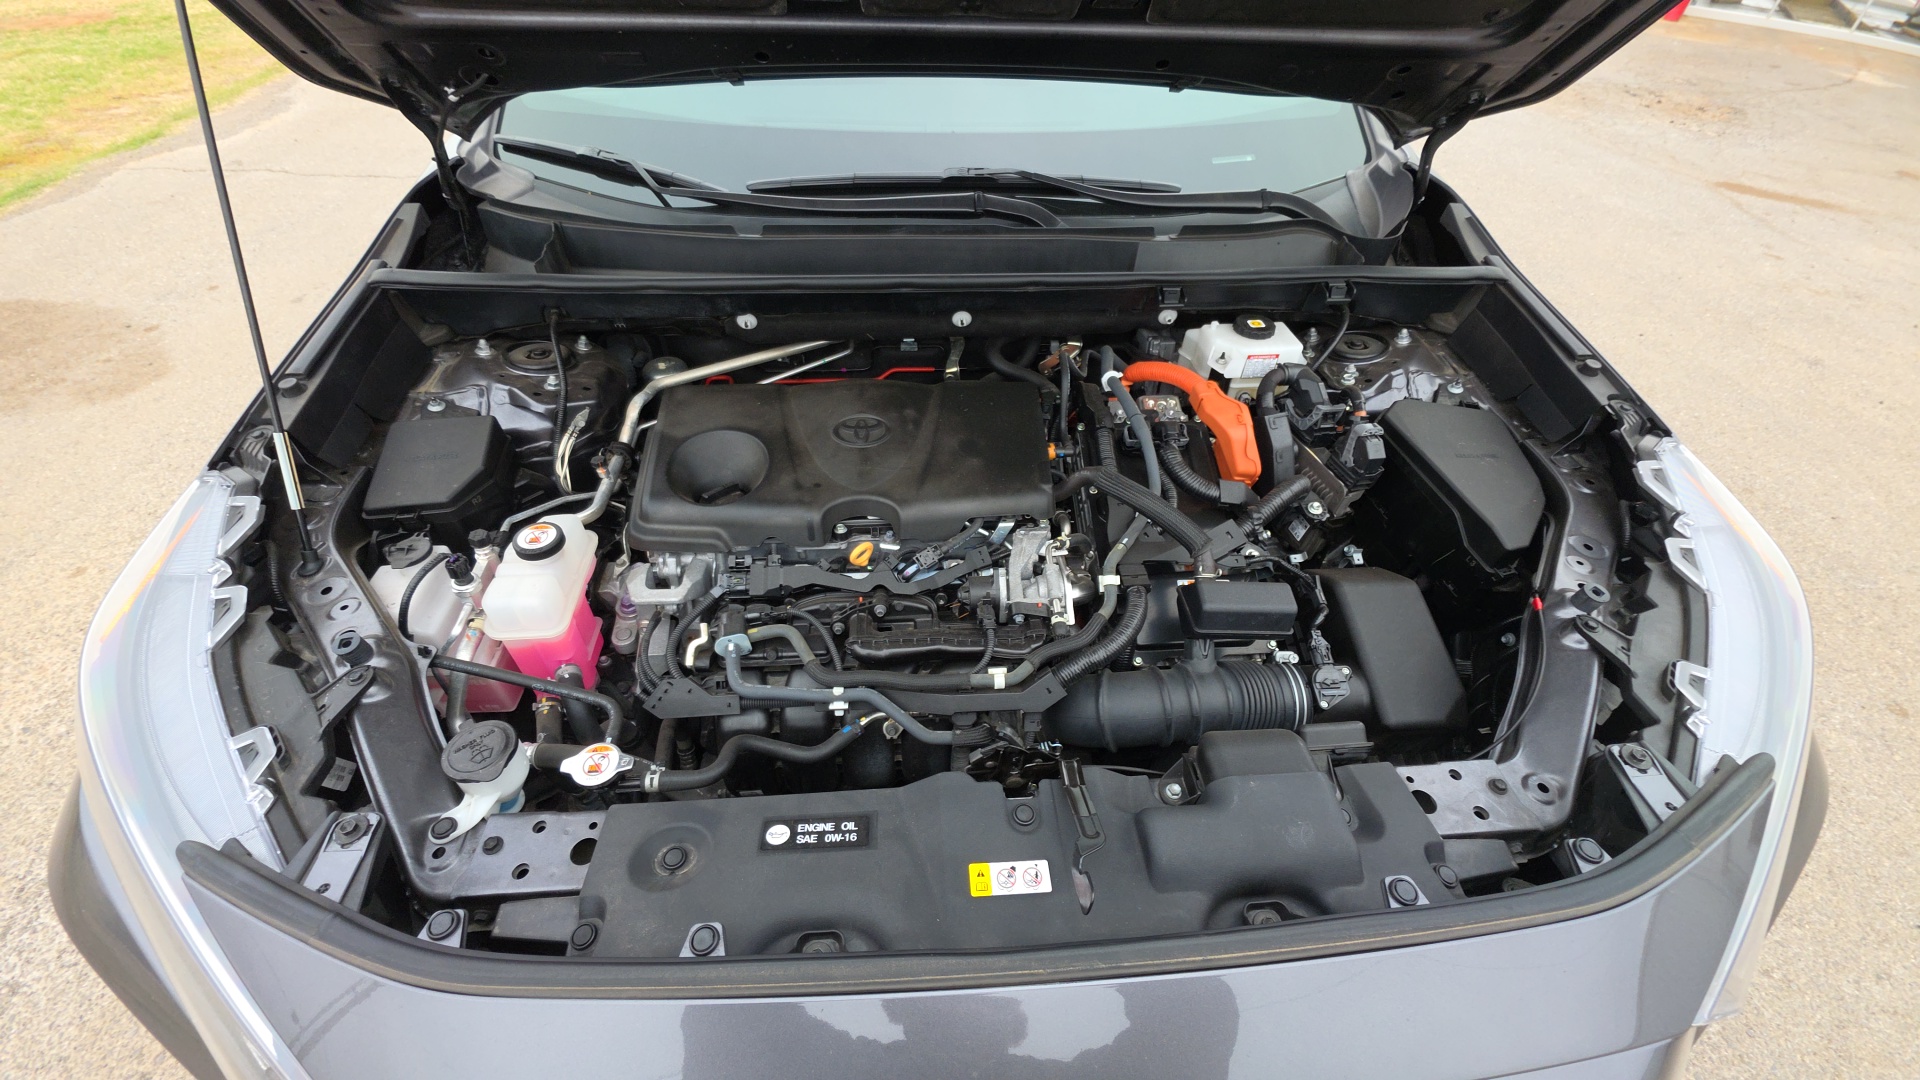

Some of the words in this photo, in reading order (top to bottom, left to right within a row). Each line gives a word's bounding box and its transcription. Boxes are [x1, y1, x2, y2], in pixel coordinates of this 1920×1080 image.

[480, 729, 496, 739] FLUID
[797, 822, 836, 833] ENGINE
[841, 821, 858, 831] OIL
[796, 834, 818, 844] SAE
[824, 833, 857, 843] 0W-16
